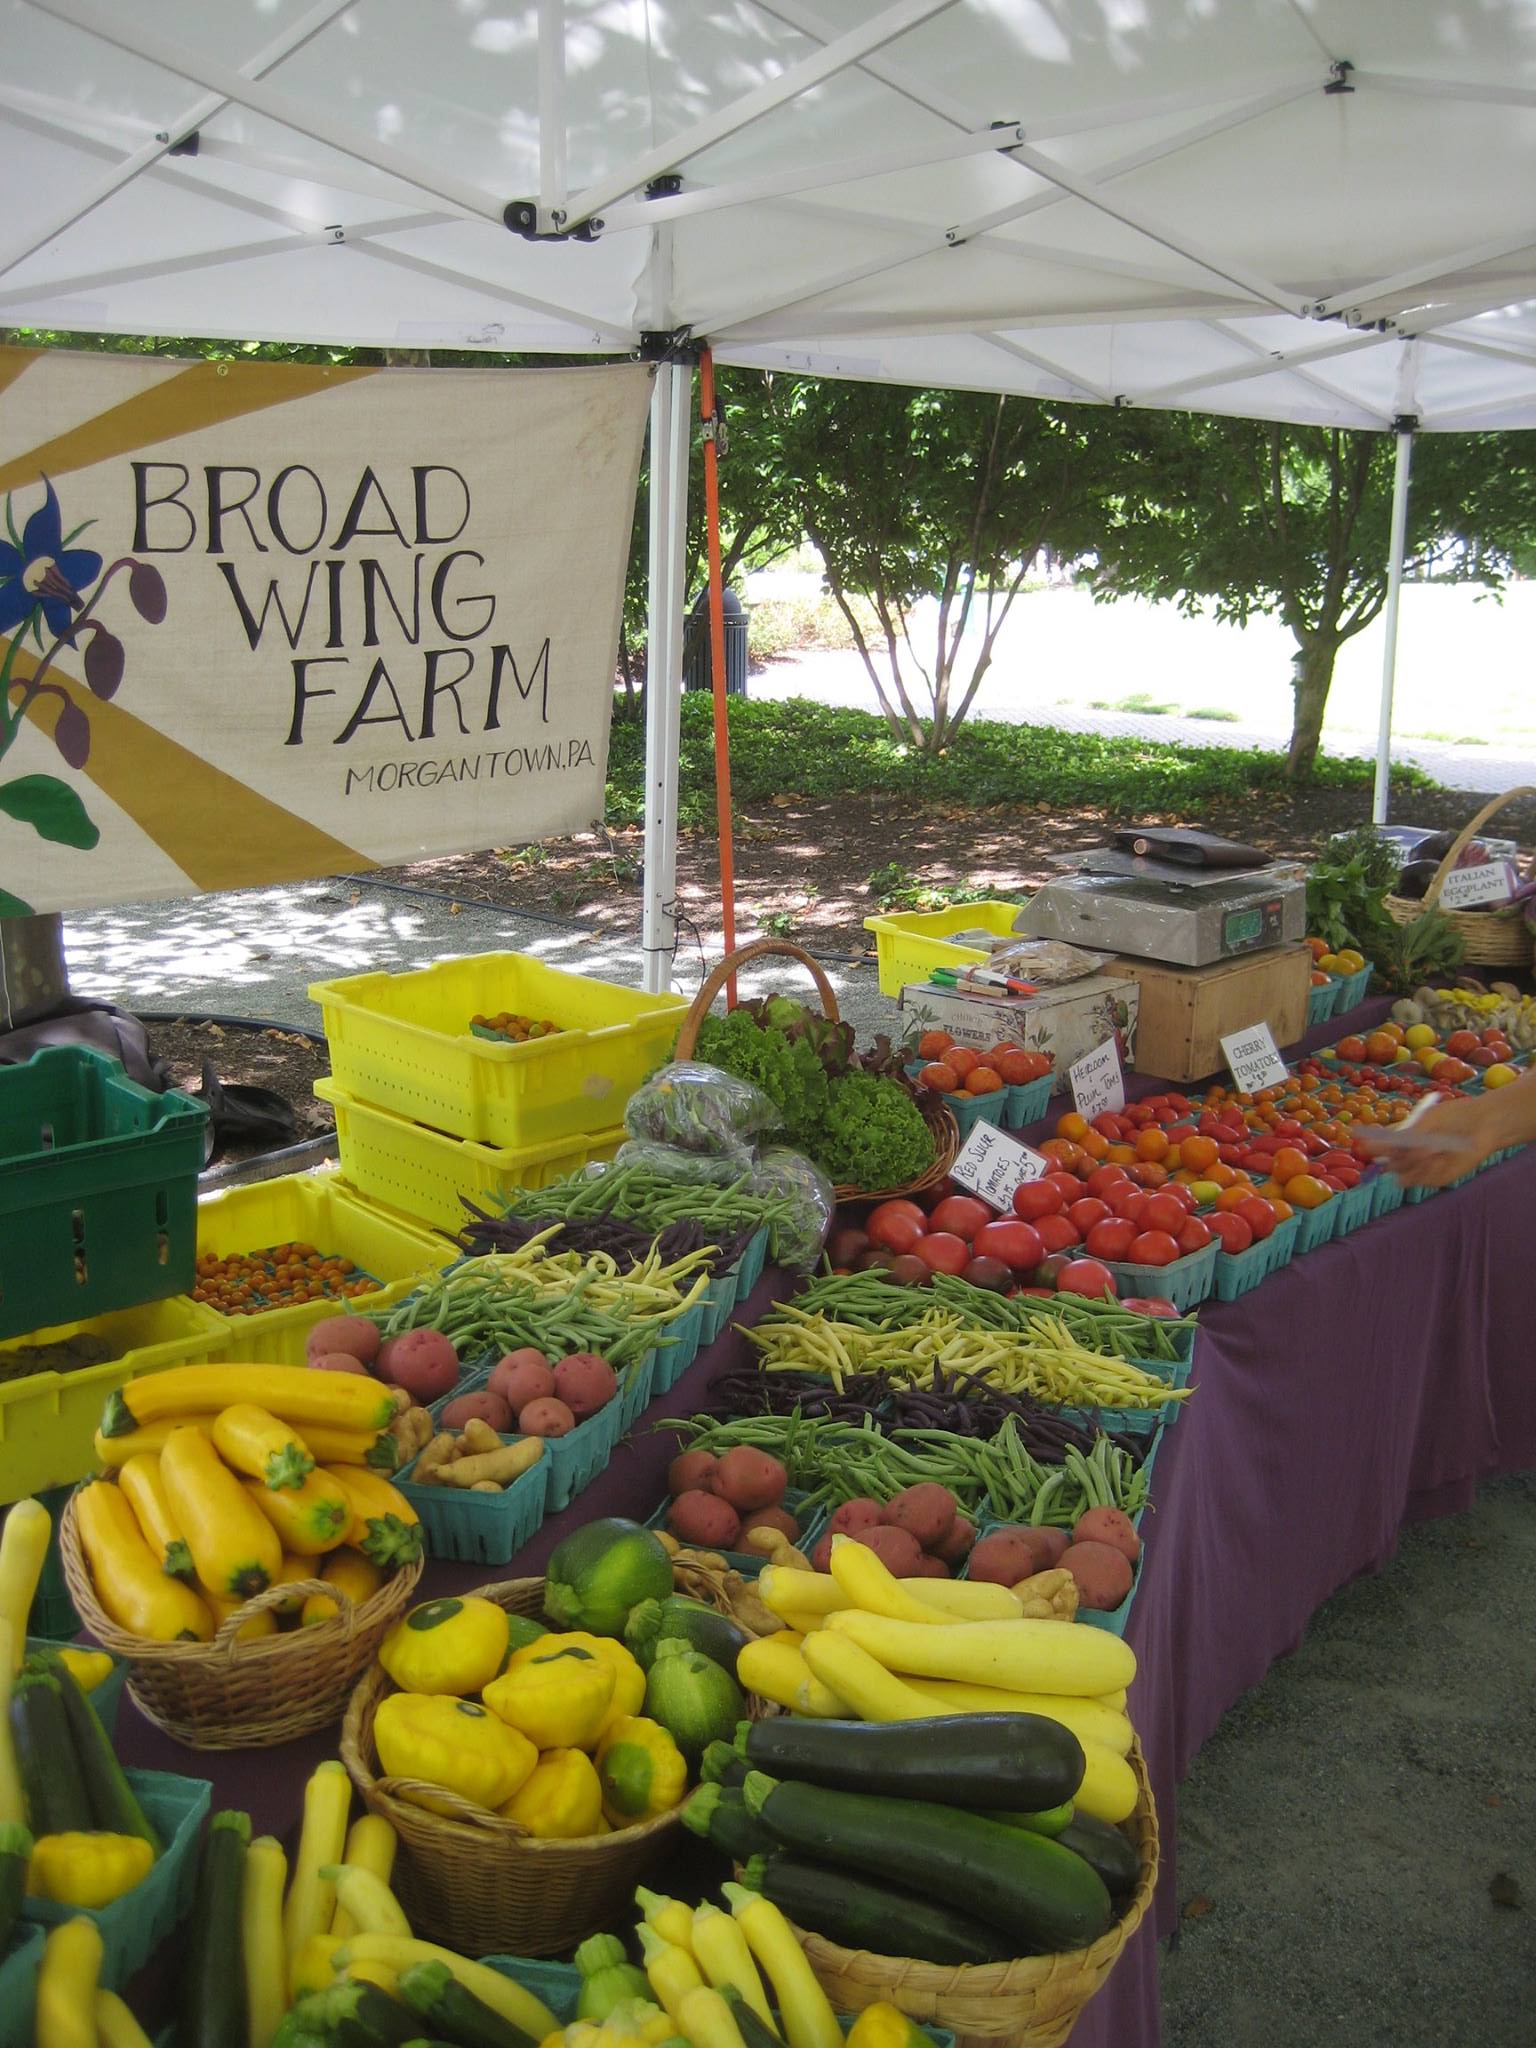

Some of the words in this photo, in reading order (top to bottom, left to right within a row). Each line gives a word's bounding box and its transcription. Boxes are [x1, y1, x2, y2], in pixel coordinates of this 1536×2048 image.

[131, 461, 472, 555] BROAD
[217, 549, 497, 653] WING
[283, 637, 550, 746] FARM
[1448, 868, 1496, 885] ITALIAN
[1443, 879, 1504, 897] EGGPLANT
[943, 1023, 991, 1042] FLOWERS
[1233, 1037, 1267, 1059] CHERRY
[953, 1161, 978, 1181] RED
[975, 1156, 1010, 1197] TOMATOES
